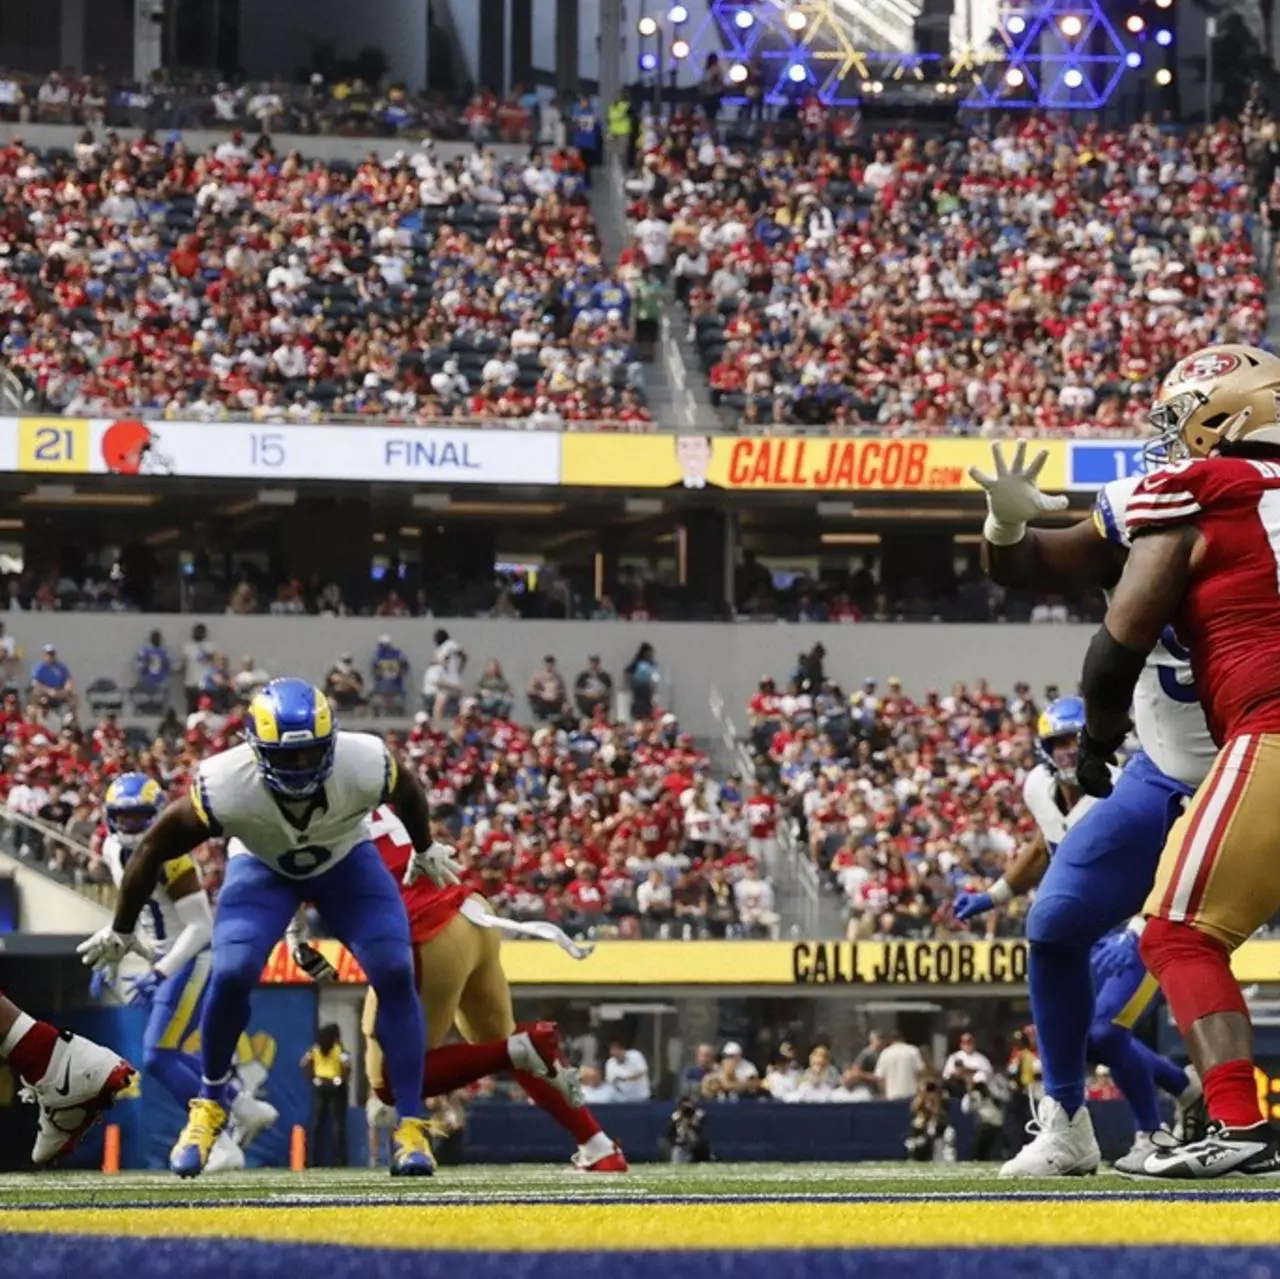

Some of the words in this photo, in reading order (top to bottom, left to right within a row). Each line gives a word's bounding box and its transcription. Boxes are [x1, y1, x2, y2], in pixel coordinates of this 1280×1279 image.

[34, 427, 74, 461] 21
[250, 432, 286, 468] 15
[385, 440, 481, 468] FINAL
[793, 943, 865, 983] CALL
